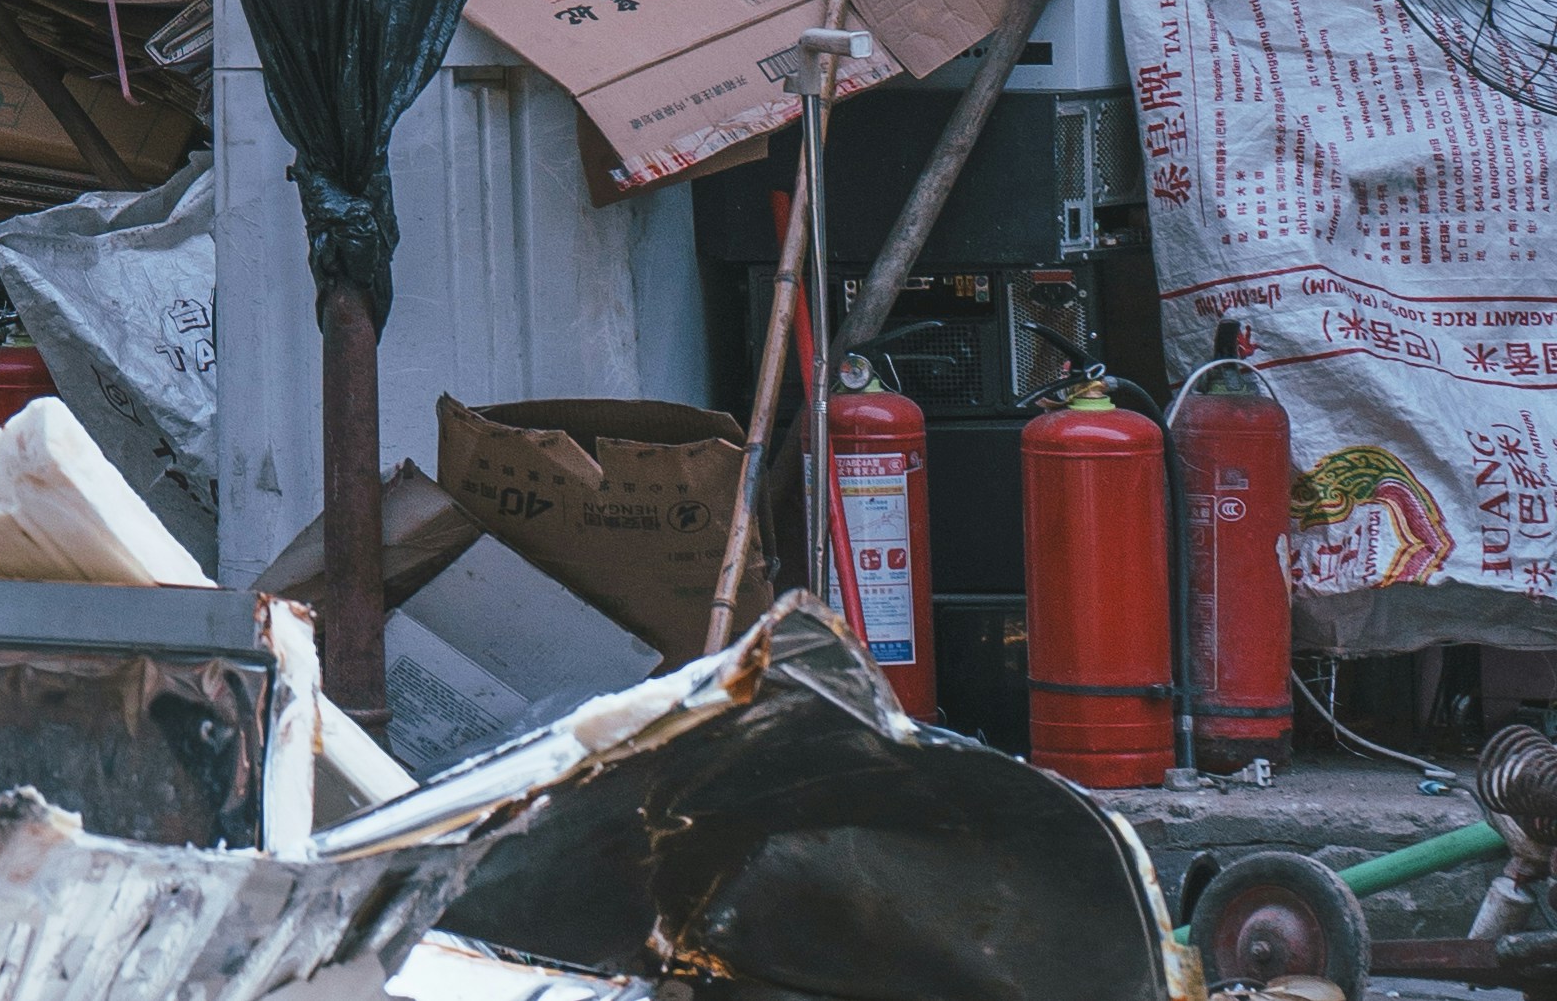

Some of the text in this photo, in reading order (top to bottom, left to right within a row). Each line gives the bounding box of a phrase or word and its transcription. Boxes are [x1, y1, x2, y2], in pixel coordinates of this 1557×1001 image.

[1373, 5, 1386, 25] cool
[1161, 20, 1181, 57] TAI
[1382, 38, 1394, 51] dry
[1259, 32, 1281, 84] longgang
[1305, 49, 1318, 72] (Fax)
[1365, 52, 1378, 77] Years
[1387, 54, 1396, 62] in
[1406, 44, 1426, 96] Production
[1212, 60, 1223, 102] Description
[1232, 54, 1243, 102] Ingredient
[1254, 76, 1263, 102] Place
[1318, 29, 1354, 142] Usage Food Processing
[1391, 65, 1404, 90] Store
[1356, 91, 1371, 124] Weight
[1377, 94, 1389, 112] Life
[1420, 99, 1429, 108] of
[1384, 115, 1395, 135] Shelf
[1401, 99, 1415, 132] Storage
[1424, 110, 1435, 129] Date
[1136, 60, 1192, 210] 泰皇牌
[1444, 125, 1457, 144] RICE
[1498, 118, 1509, 142] RICE
[1294, 130, 1306, 187] shenzhen
[1452, 144, 1465, 185] GOLDEN
[1503, 145, 1517, 185] GOLDEN
[1472, 159, 1482, 183] MOO
[1524, 160, 1533, 184] MOO
[1455, 187, 1466, 212] ASIA
[1507, 187, 1518, 211] ASIA
[1381, 301, 1427, 324] 100%
[1432, 311, 1477, 327] RICE
[583, 501, 658, 516] HENGAN
